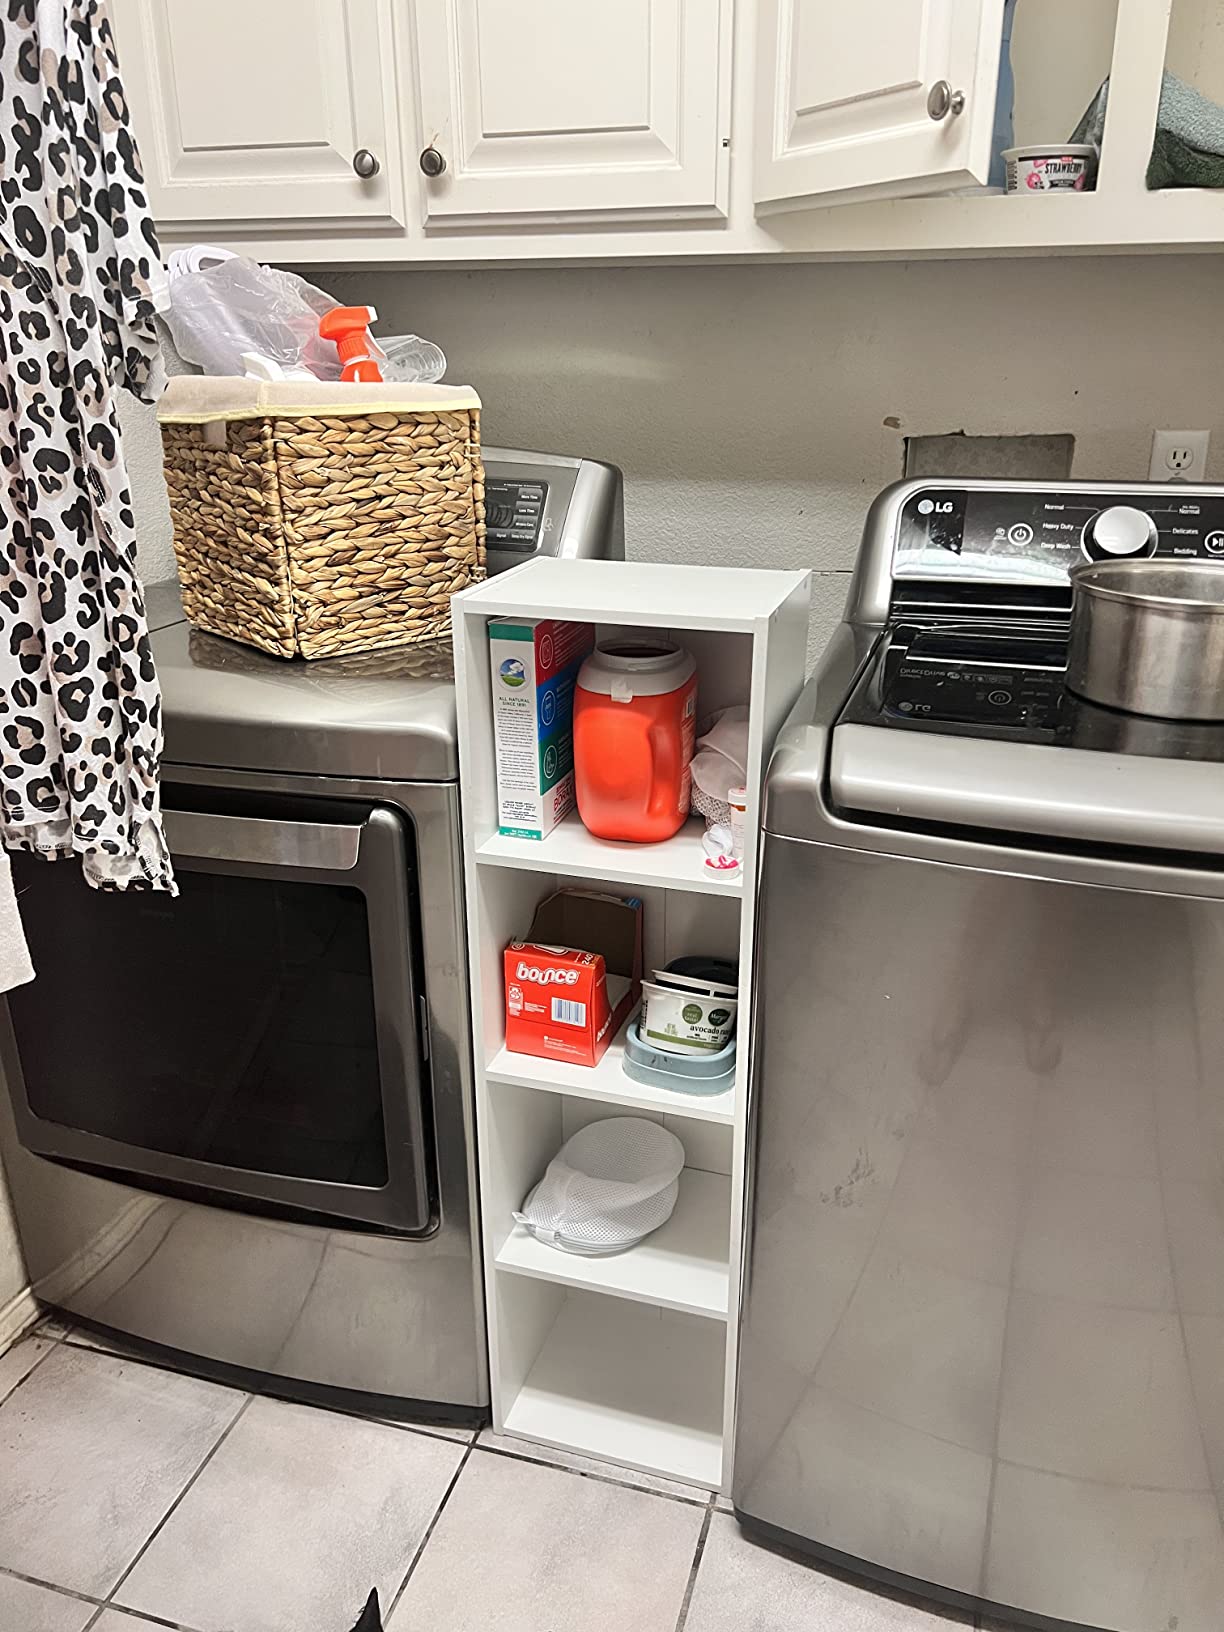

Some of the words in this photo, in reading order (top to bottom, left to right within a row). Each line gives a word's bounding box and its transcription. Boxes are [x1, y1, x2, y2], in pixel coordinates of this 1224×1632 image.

[935, 501, 954, 513] LG
[1042, 522, 1060, 531] Heavy
[1060, 523, 1074, 532] Duty
[1172, 527, 1199, 535] Delicates
[517, 962, 580, 985] bounce
[689, 1025, 720, 1035] avocado
